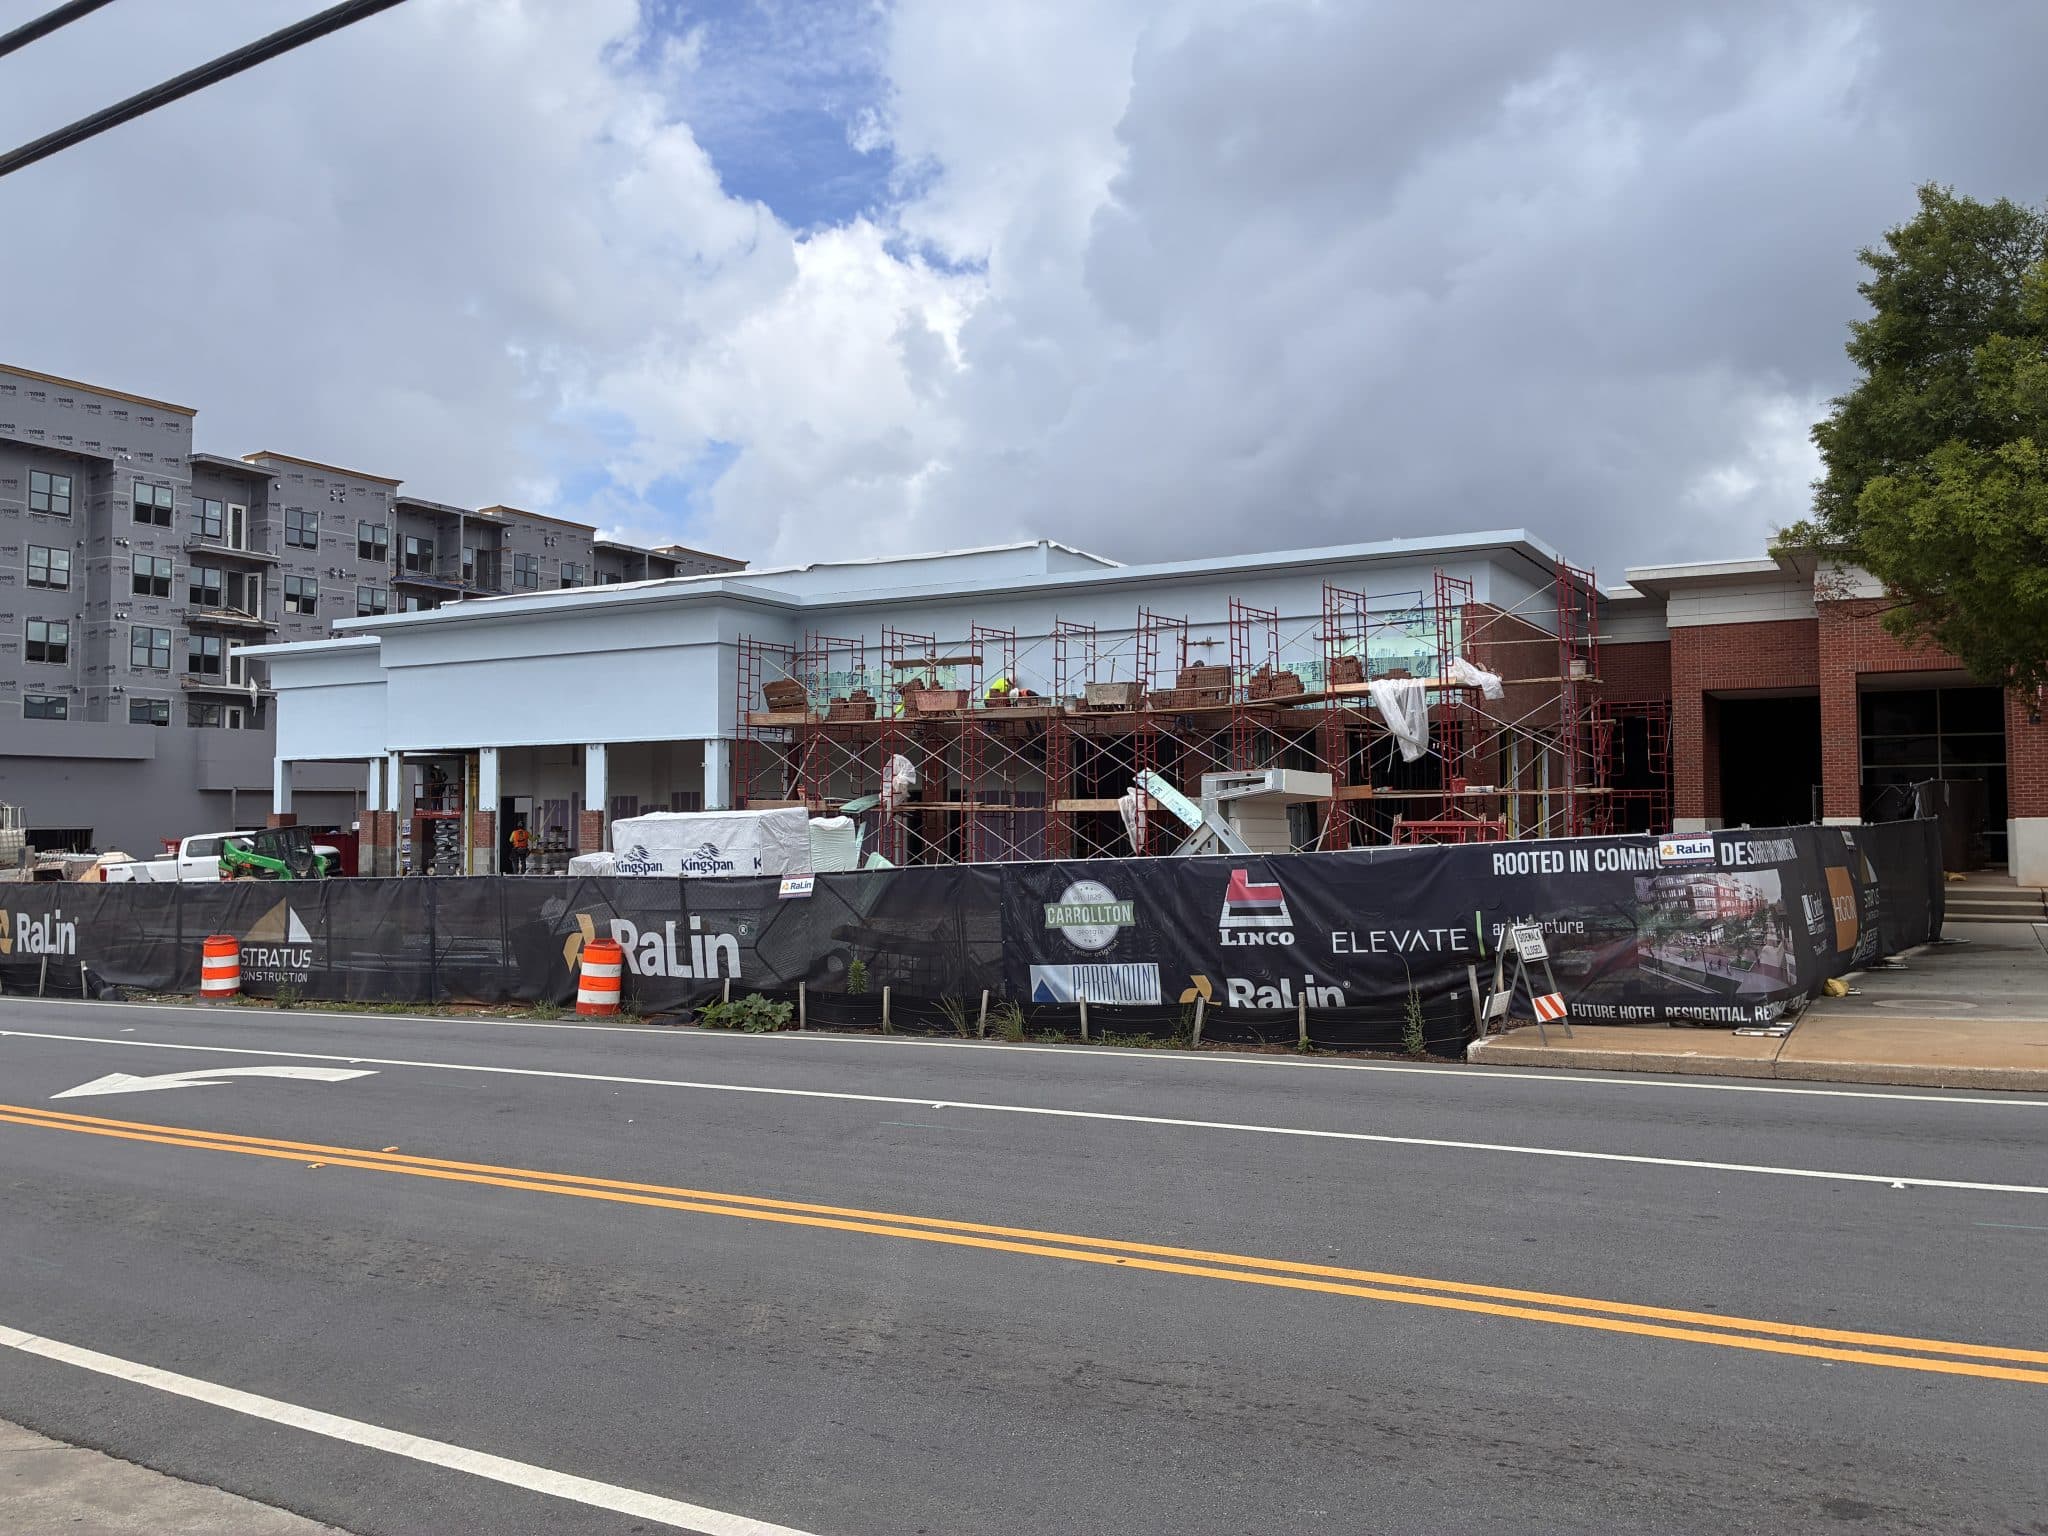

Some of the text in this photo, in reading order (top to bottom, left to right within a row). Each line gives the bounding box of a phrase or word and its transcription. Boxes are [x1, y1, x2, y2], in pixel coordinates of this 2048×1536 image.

[1676, 843, 1711, 854] RaLin
[615, 860, 663, 875] Kingspan
[681, 857, 734, 874] Kingspan
[1493, 850, 1565, 876] ROOTED
[1569, 849, 1589, 873] IN
[790, 881, 812, 890] RaLin
[1047, 904, 1131, 924] CARROLLTON
[17, 909, 76, 955] RaLin
[1331, 928, 1469, 953] ELEVATE
[611, 915, 742, 978] RaLin
[1524, 944, 1543, 955] CLOSED
[241, 948, 313, 968] STRATUS
[1073, 964, 1158, 1001] PARAMOUNT
[1226, 974, 1346, 1009] RaLin
[1571, 1003, 1617, 1019] FUTURE
